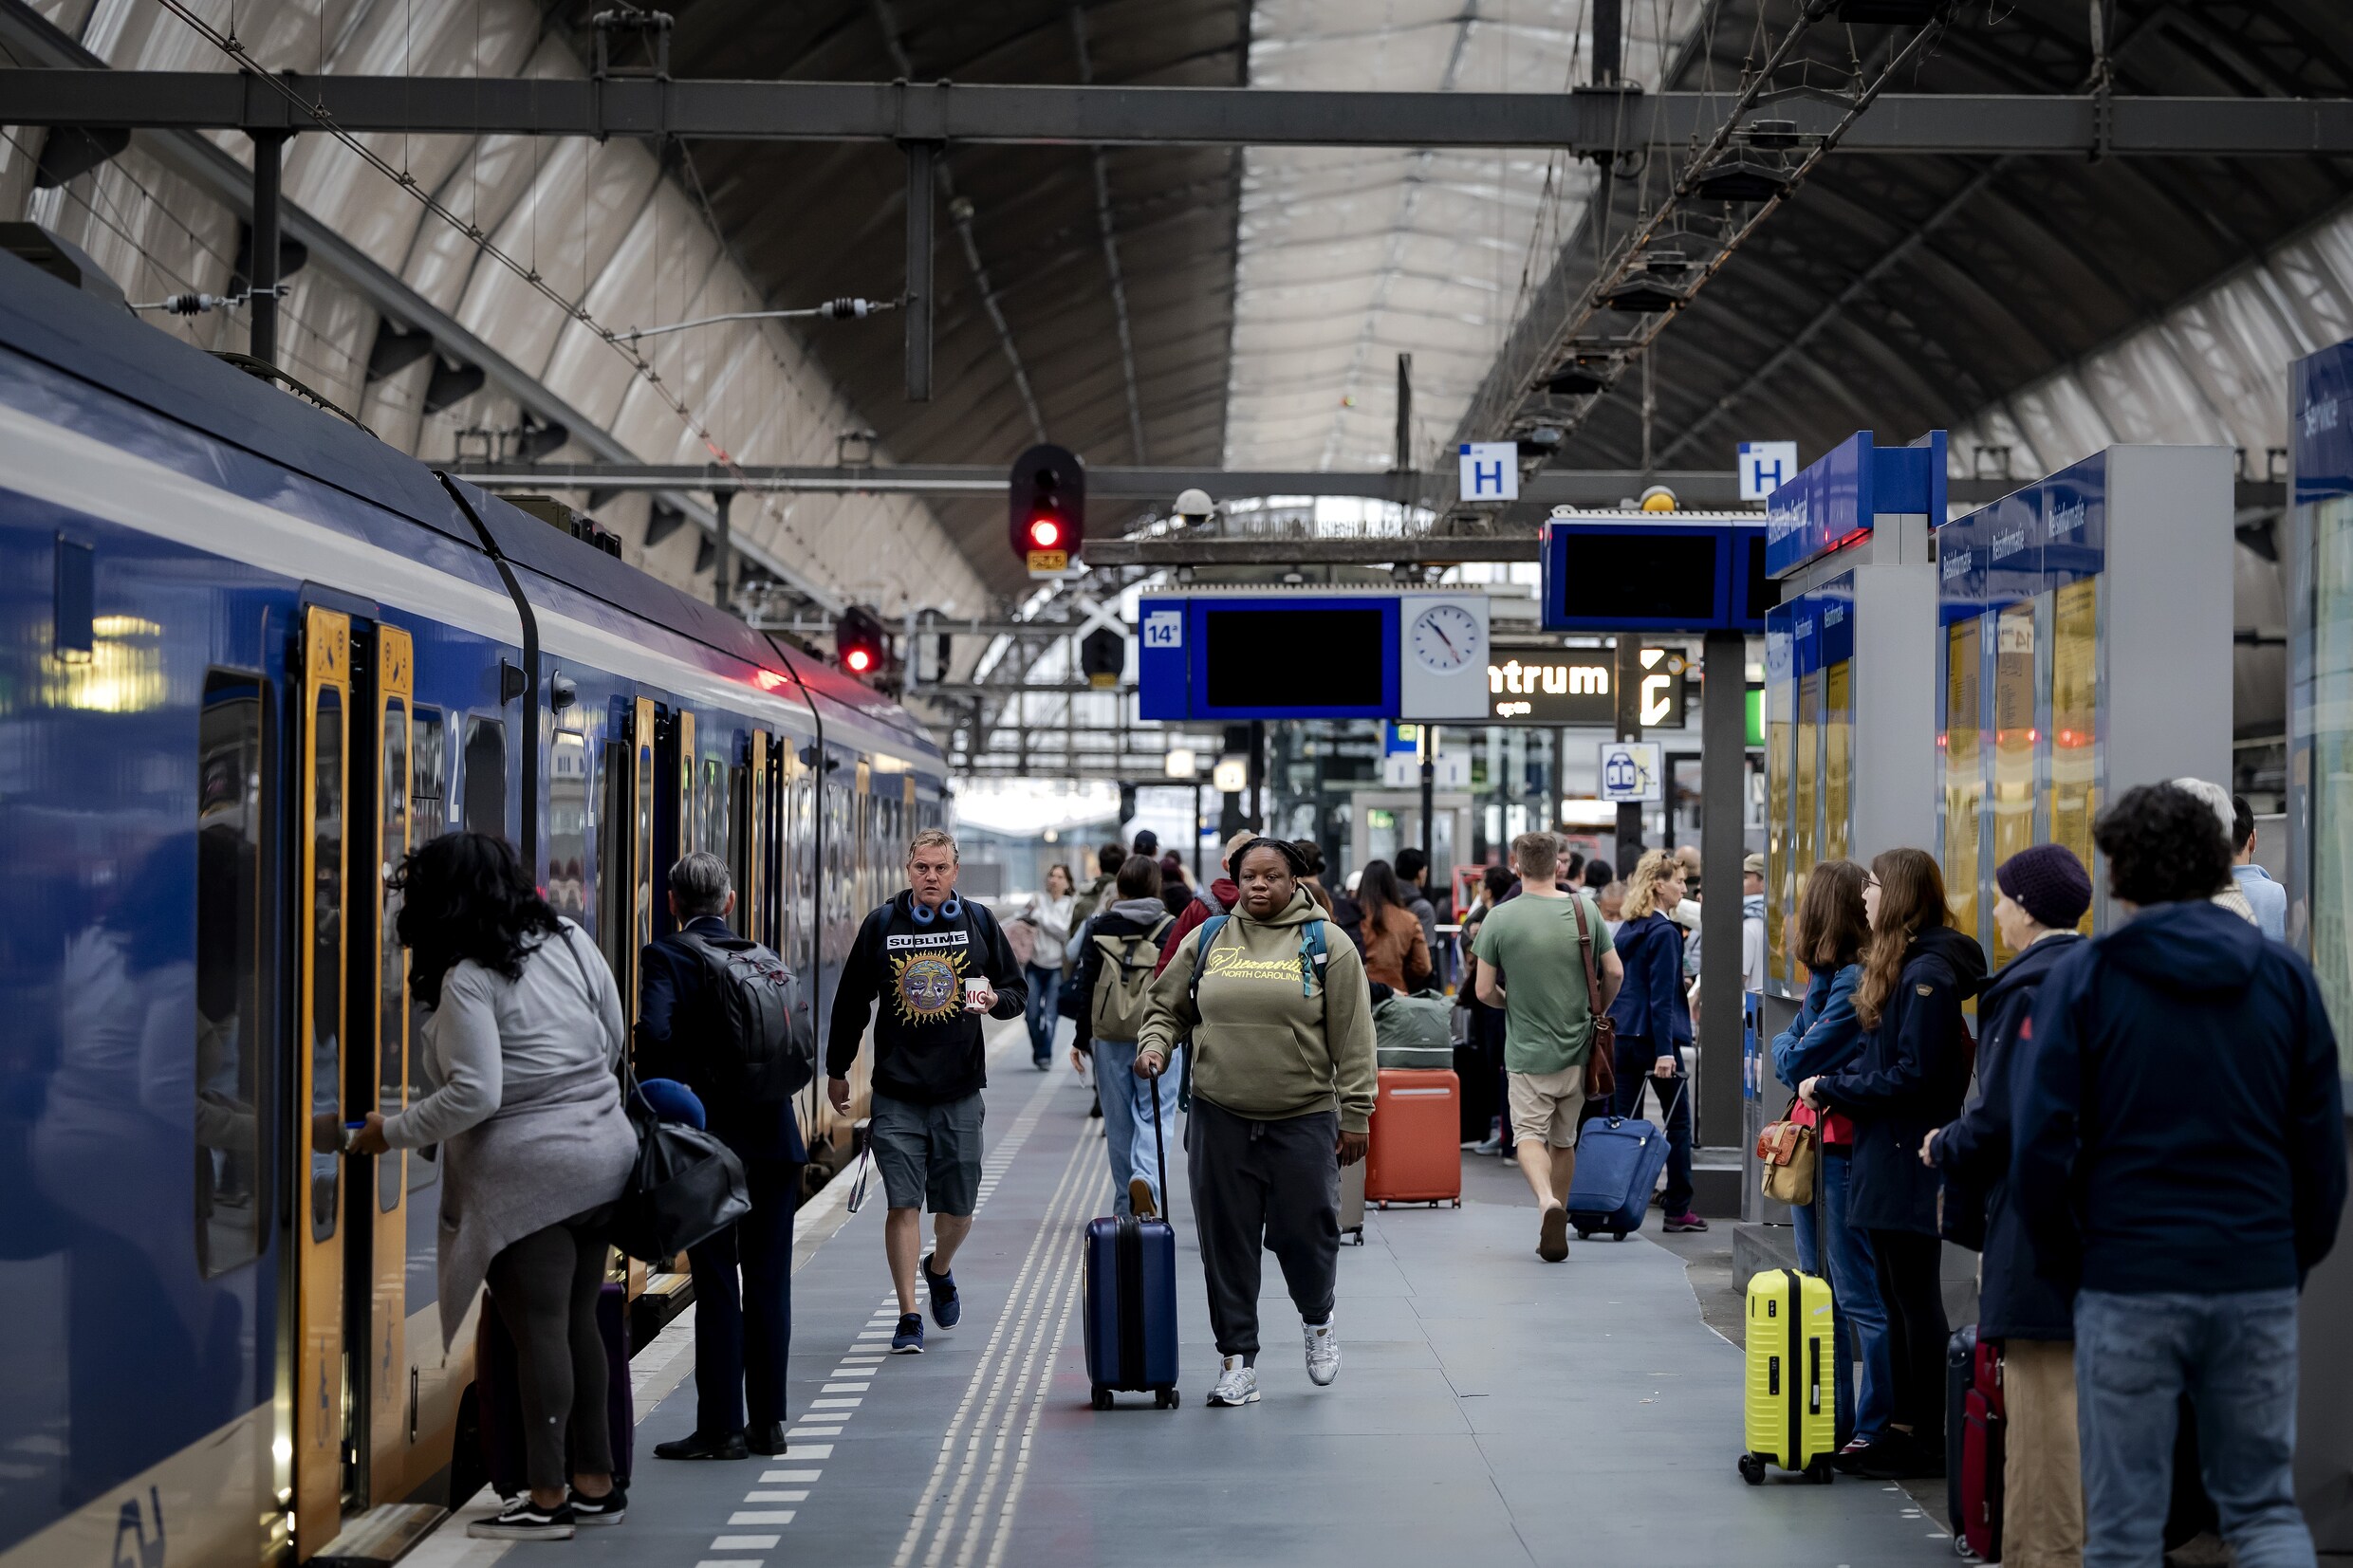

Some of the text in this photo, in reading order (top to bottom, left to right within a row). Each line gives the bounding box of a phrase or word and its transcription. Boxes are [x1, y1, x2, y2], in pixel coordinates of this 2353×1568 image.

[1474, 461, 1502, 494] H
[1754, 459, 1781, 492] H
[2048, 495, 2084, 539] Reisinformatie
[450, 710, 459, 822] 2
[588, 735, 595, 827] 2
[889, 933, 967, 947] SUBLIME
[1221, 969, 1301, 983] NORTH CAROLINA
